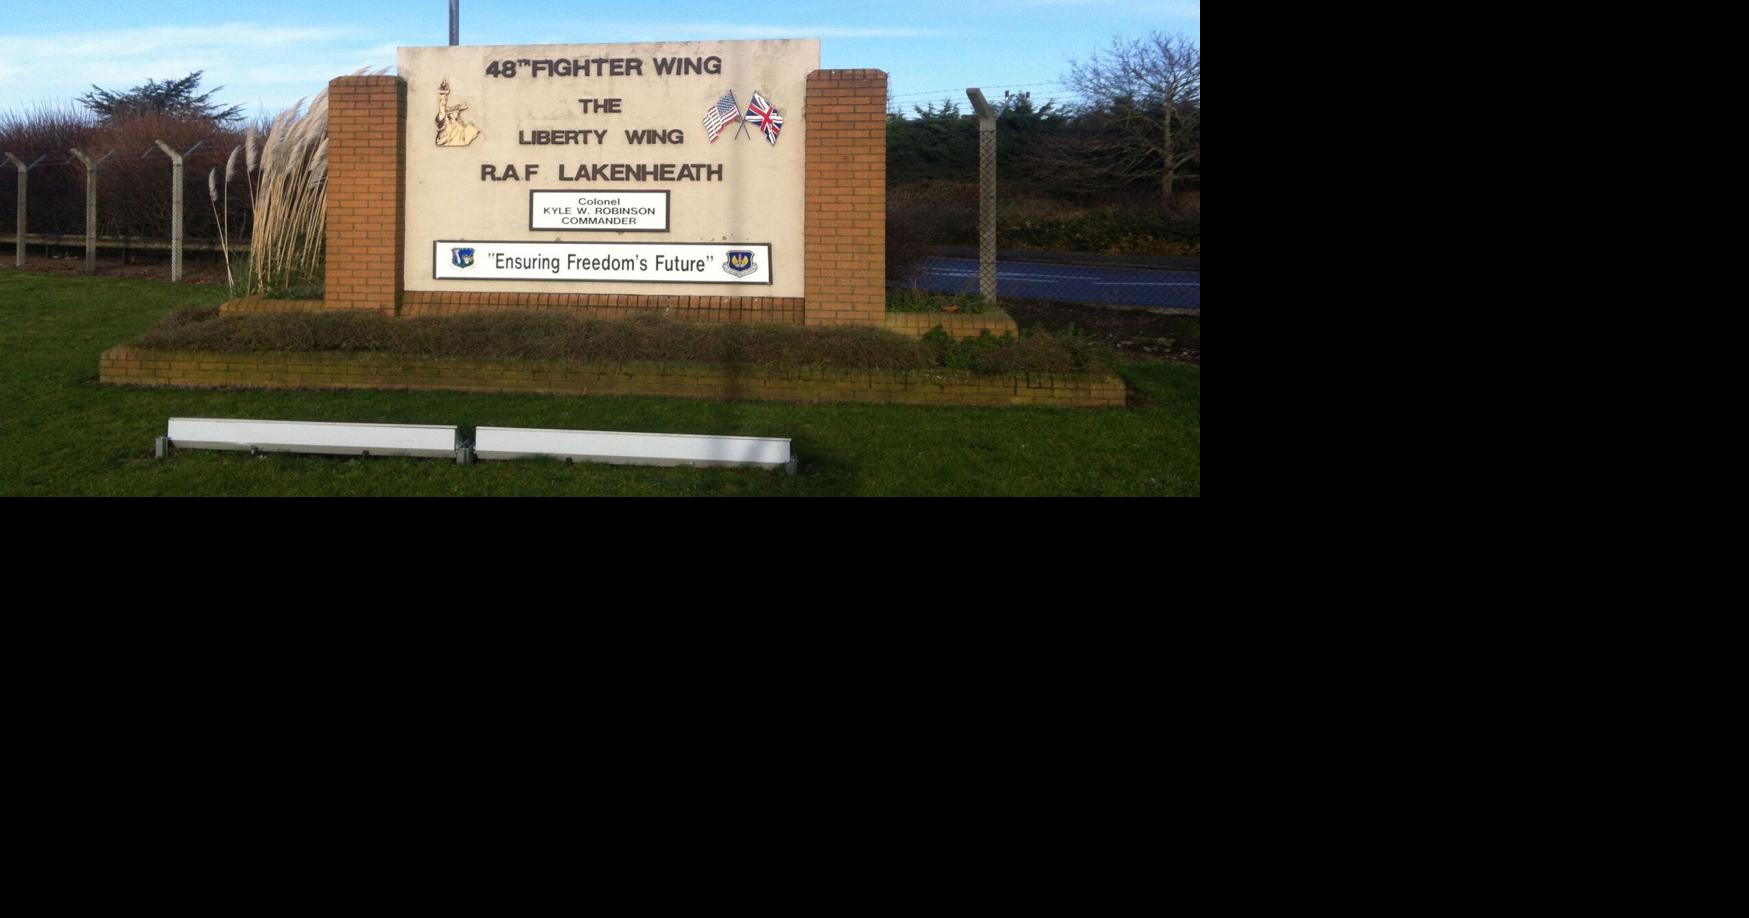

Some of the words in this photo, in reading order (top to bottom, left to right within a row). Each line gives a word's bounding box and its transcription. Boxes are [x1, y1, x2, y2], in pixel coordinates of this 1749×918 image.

[532, 57, 643, 77] FIGHTER
[653, 55, 722, 76] WING
[578, 98, 622, 114] THE
[518, 129, 608, 145] LIBERTY
[624, 128, 684, 145] WING
[558, 163, 723, 182] LAKENHEATH
[578, 197, 621, 206] Colonel
[543, 207, 572, 215] KYLE
[576, 207, 591, 215] W.
[595, 207, 656, 215] ROBINSON
[561, 216, 637, 225] COMMANDER
[488, 252, 560, 273] "Ensuring
[567, 253, 648, 271] Freedom's
